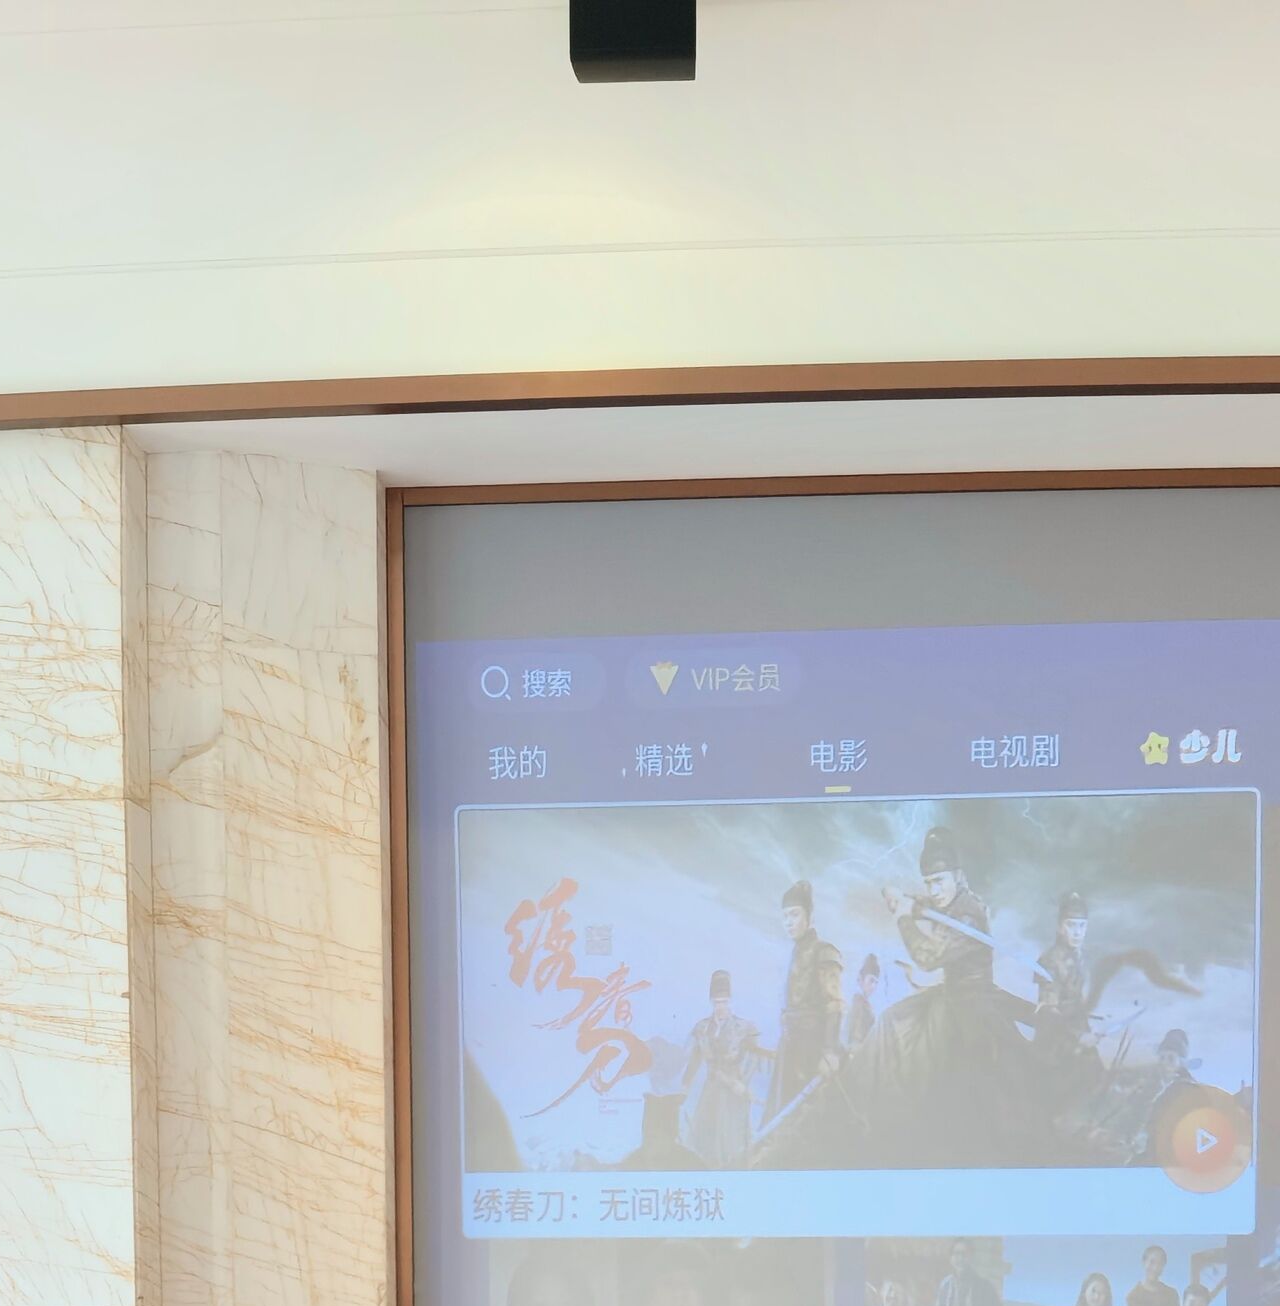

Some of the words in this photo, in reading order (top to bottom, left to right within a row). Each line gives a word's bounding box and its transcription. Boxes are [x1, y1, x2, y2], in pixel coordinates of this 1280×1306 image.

[521, 667, 573, 698] 搜索
[691, 663, 781, 693] VIP会员
[488, 746, 547, 780] 我的
[810, 738, 868, 775] 电影
[969, 732, 1061, 769] 电视剧
[1179, 728, 1242, 765] 少儿
